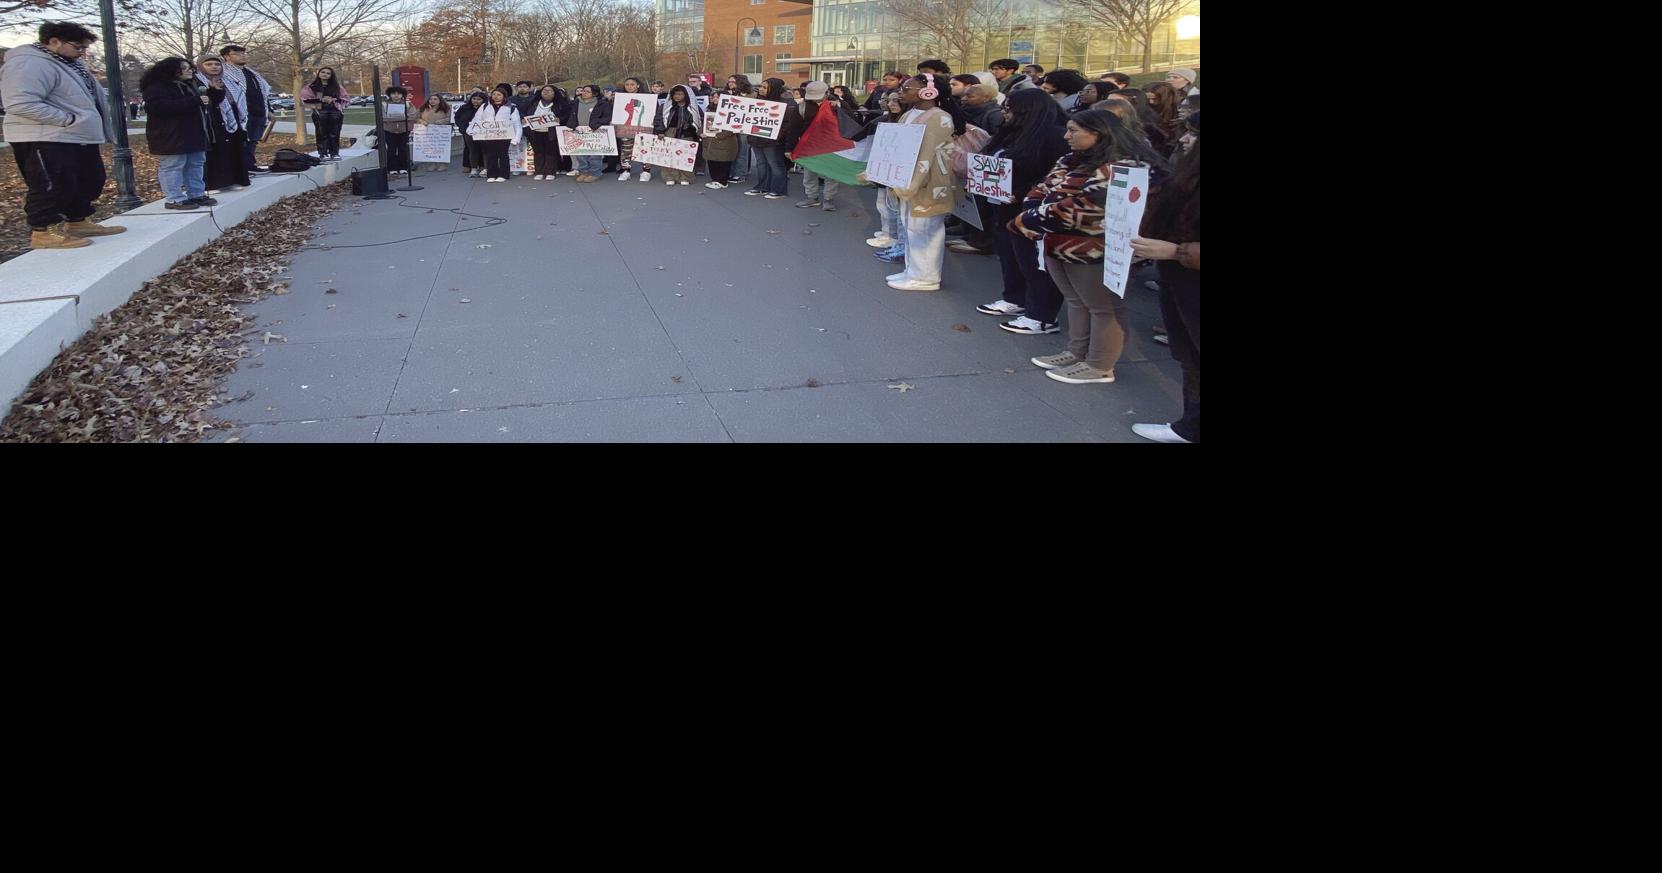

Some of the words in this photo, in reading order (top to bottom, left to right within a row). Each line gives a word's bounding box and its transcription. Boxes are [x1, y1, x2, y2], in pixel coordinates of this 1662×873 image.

[721, 98, 745, 111] Free
[748, 104, 769, 114] Free
[472, 122, 482, 130] A
[481, 120, 500, 130] Call
[726, 111, 779, 126] Palestine
[973, 154, 1008, 172] SAVE
